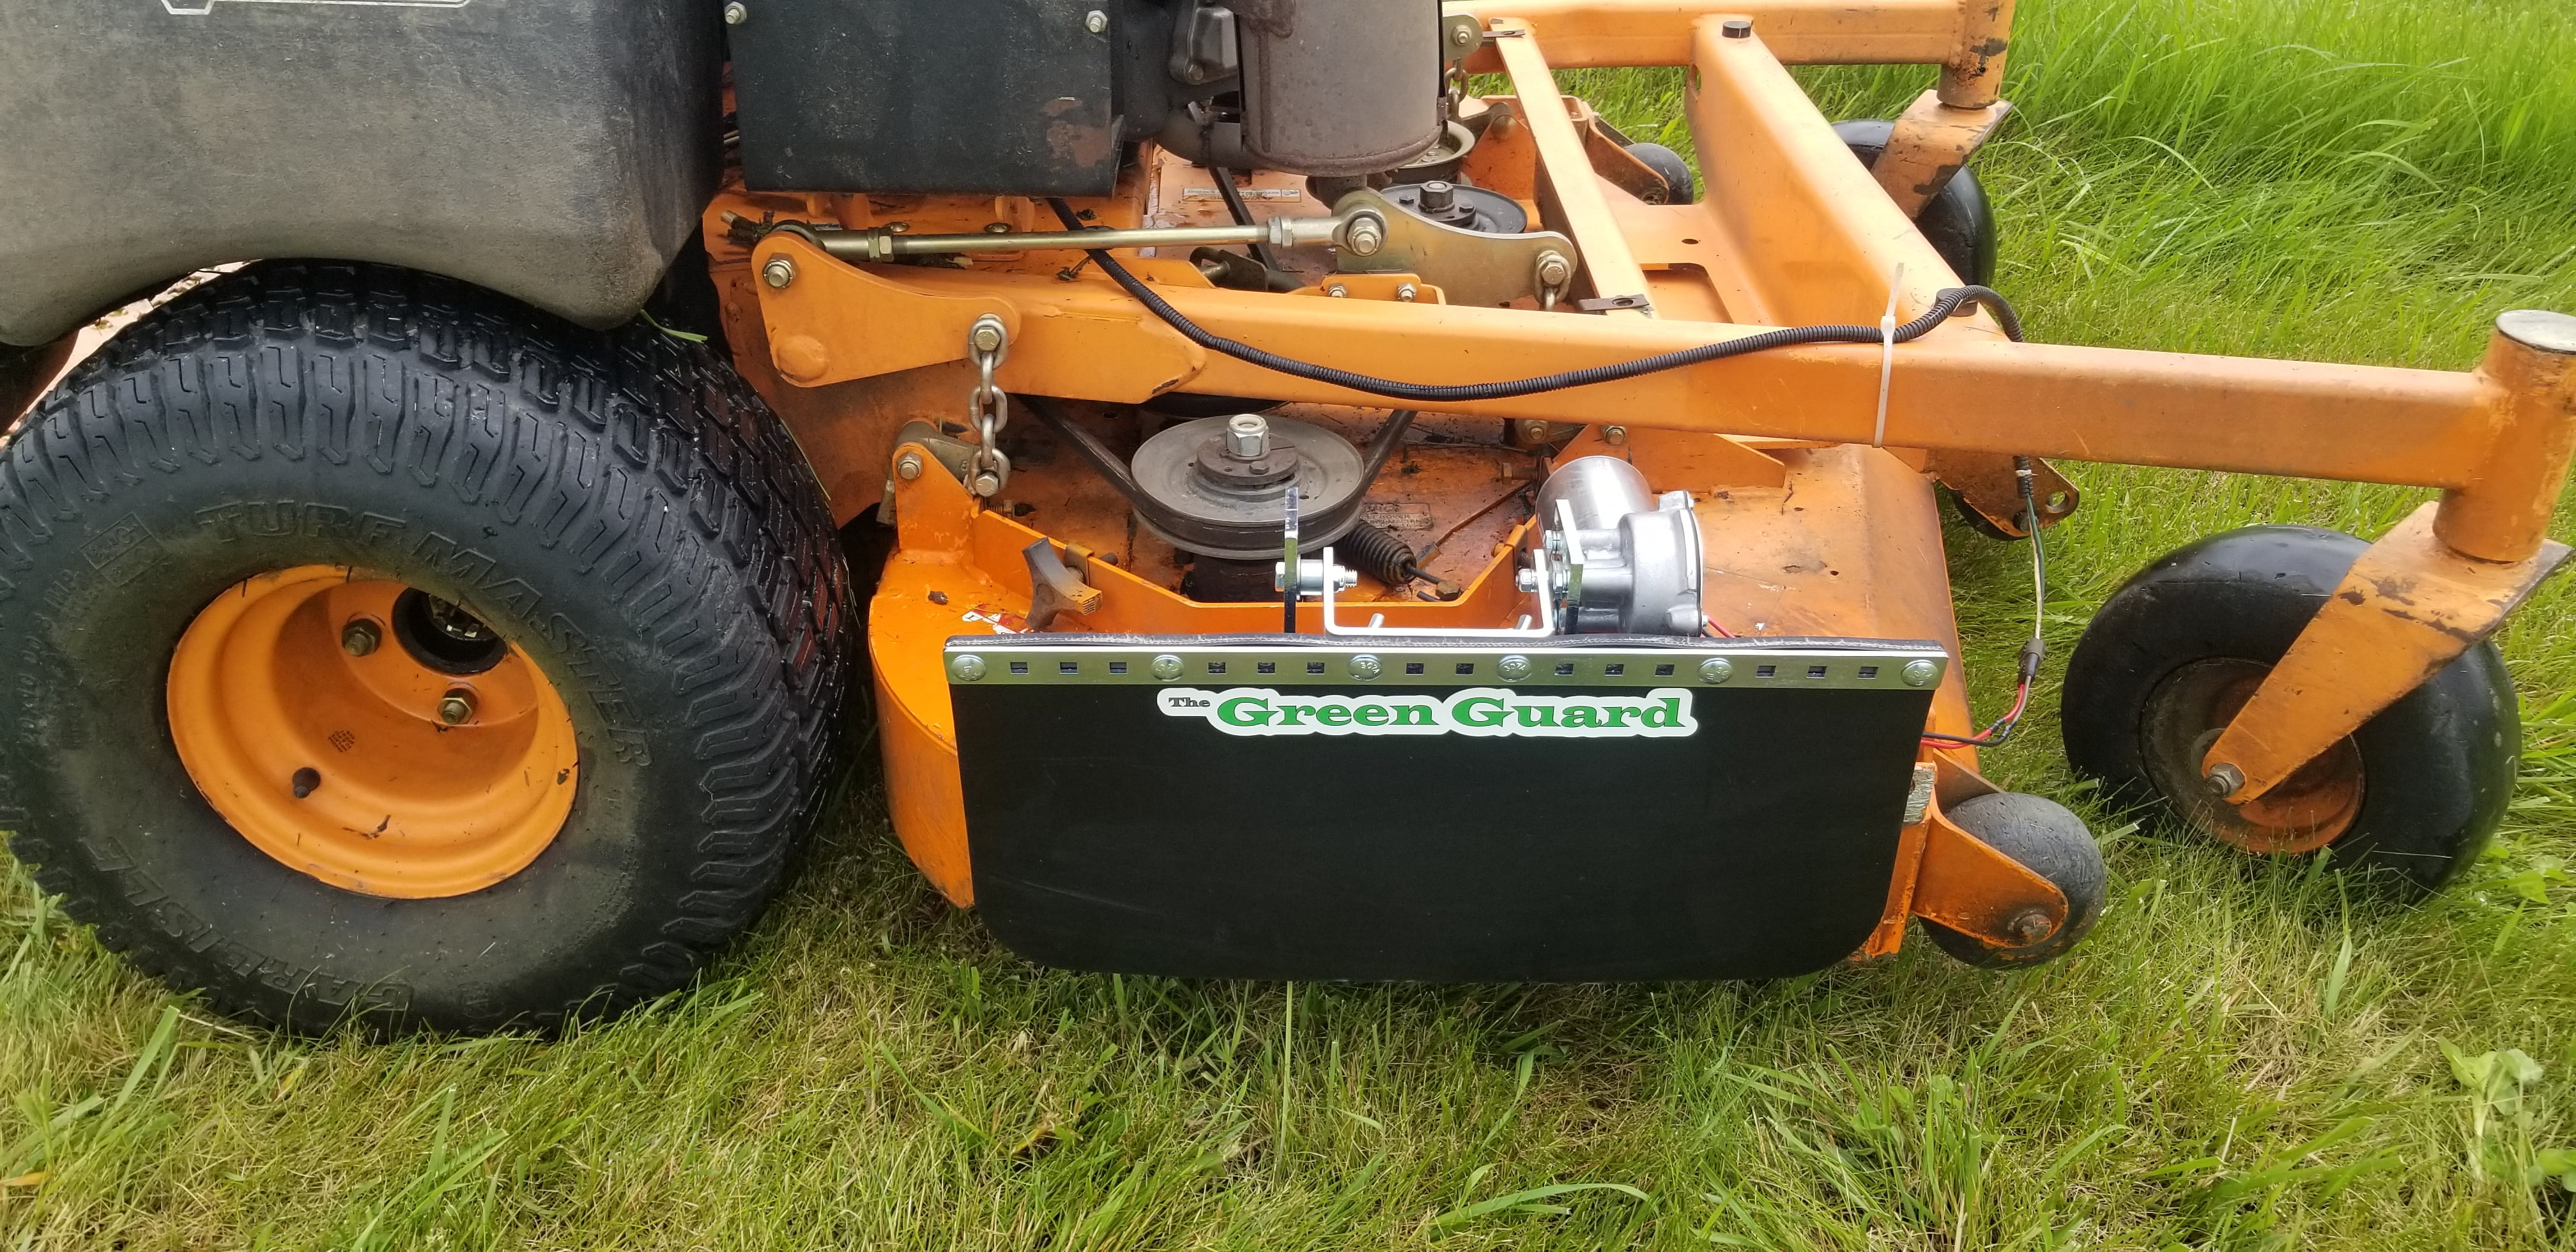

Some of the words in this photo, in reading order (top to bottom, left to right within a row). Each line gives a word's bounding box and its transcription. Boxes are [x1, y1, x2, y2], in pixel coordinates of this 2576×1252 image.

[194, 499, 408, 544] TURF
[409, 531, 656, 767] MASTER
[1168, 697, 1211, 707] The
[1217, 697, 1439, 727] Green
[1452, 697, 1686, 728] Guard
[77, 834, 413, 1012] CARLISLE
